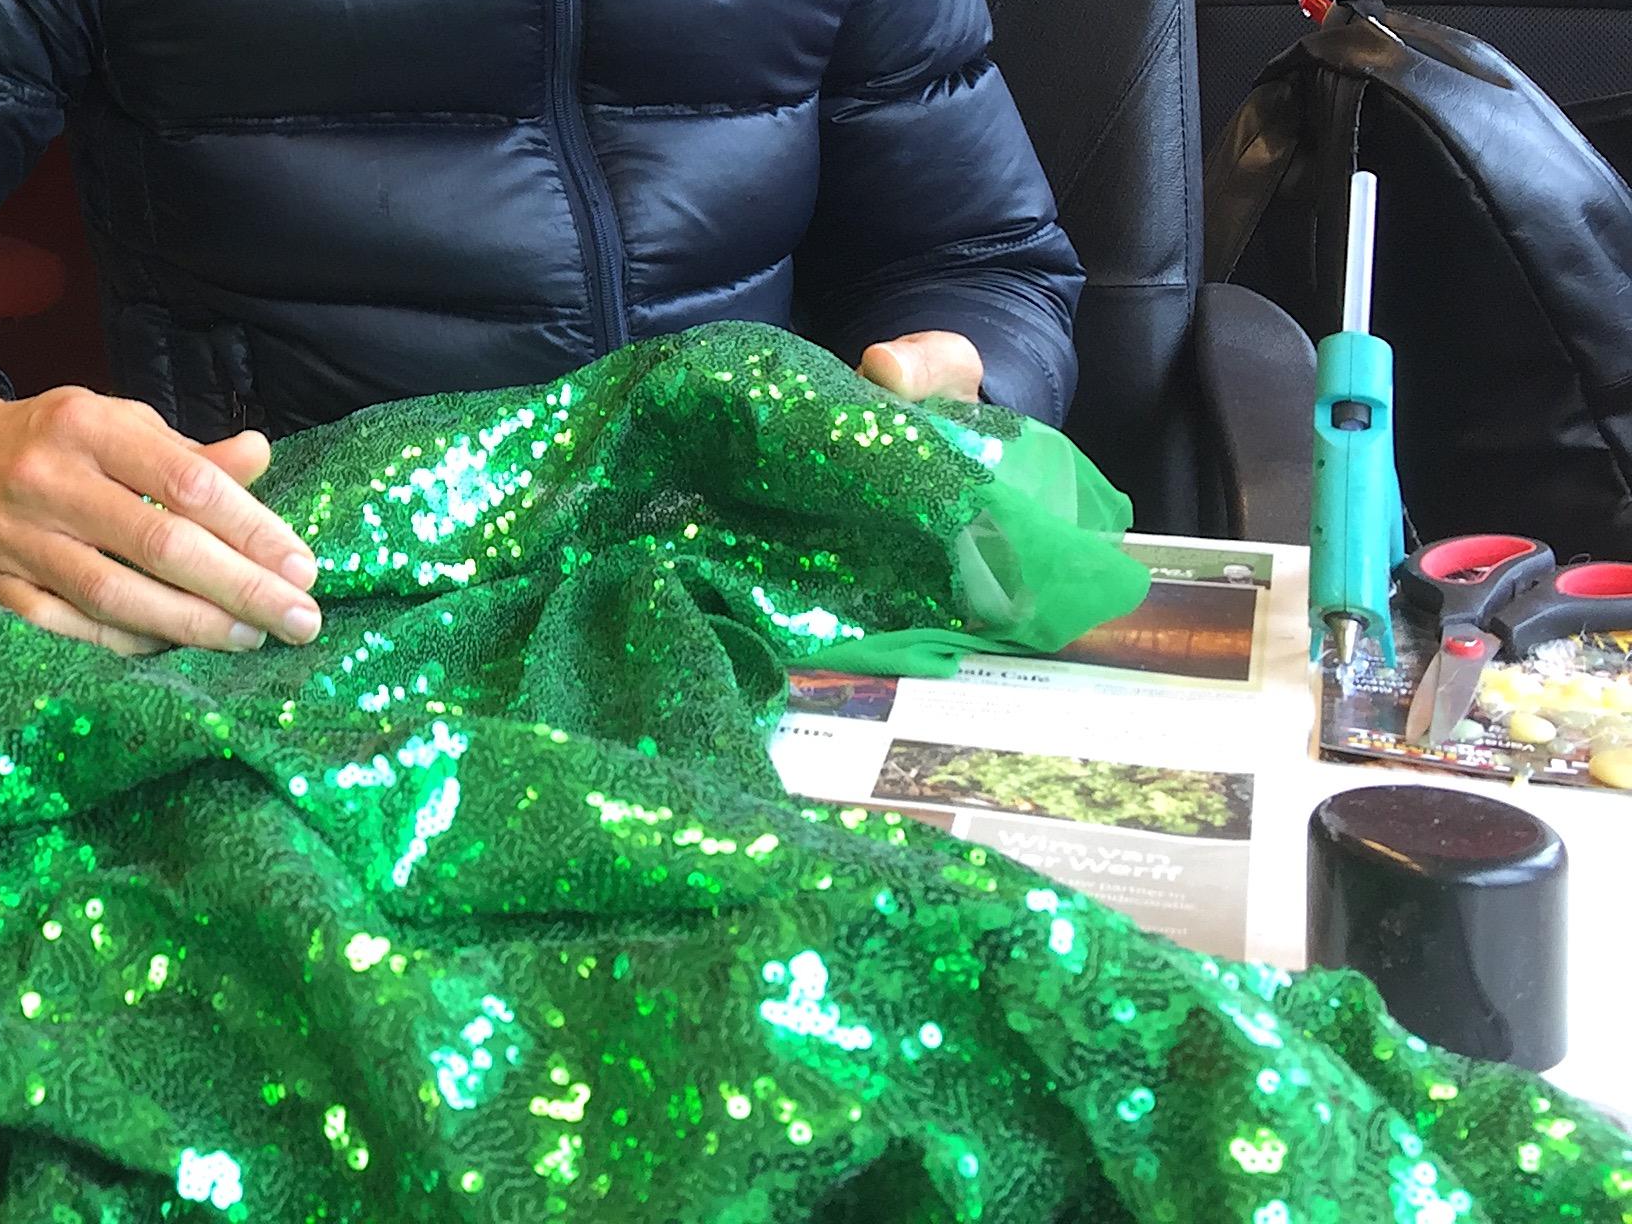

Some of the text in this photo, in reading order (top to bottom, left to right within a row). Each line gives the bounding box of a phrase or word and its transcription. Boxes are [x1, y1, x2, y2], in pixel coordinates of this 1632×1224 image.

[998, 830, 1170, 867] Wim van
[1069, 856, 1184, 881] Werff
